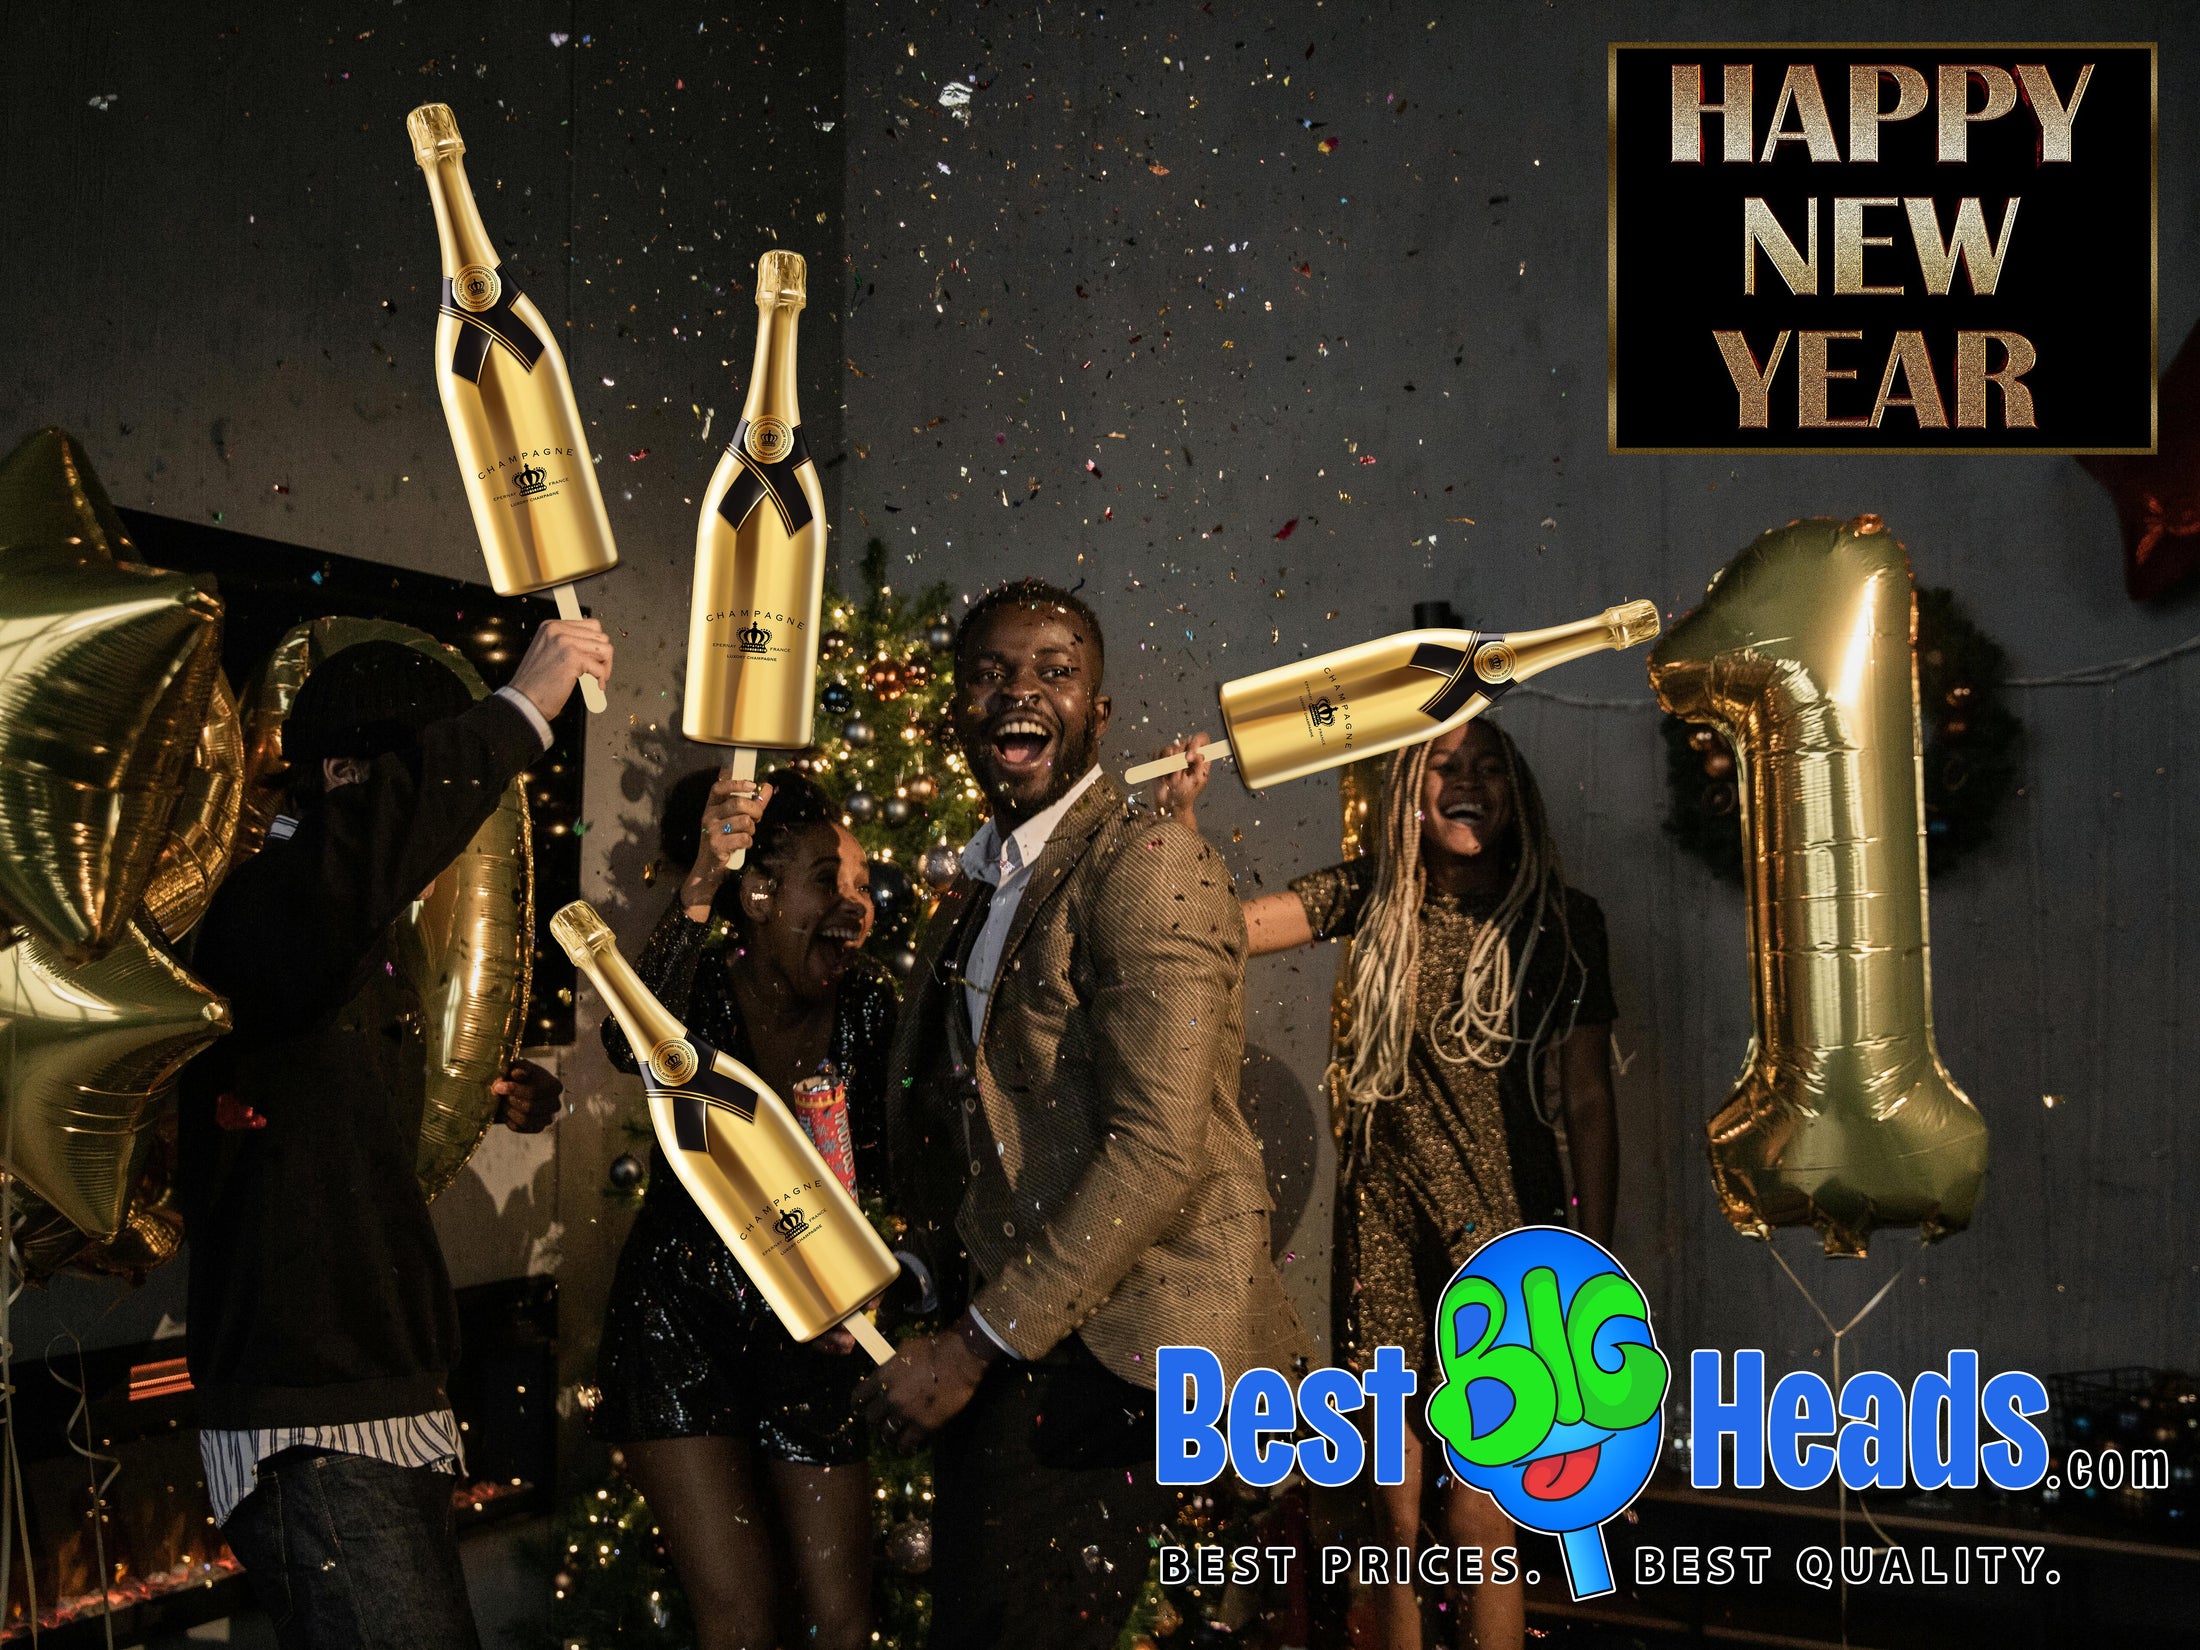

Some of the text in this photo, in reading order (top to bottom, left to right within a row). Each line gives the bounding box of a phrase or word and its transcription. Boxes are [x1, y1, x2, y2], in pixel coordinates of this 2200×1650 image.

[478, 447, 574, 481] CHAMPAGNE
[548, 477, 570, 487] FRANCE
[530, 491, 560, 502] CHAMPAGNE
[706, 609, 805, 630] CHAMPAGNE
[1323, 667, 1353, 749] CHAMPAGNE
[740, 1180, 822, 1241] CHAMPAGNE
[808, 1208, 827, 1222] FRANCE
[796, 1224, 823, 1244] CHAMPAGNE
